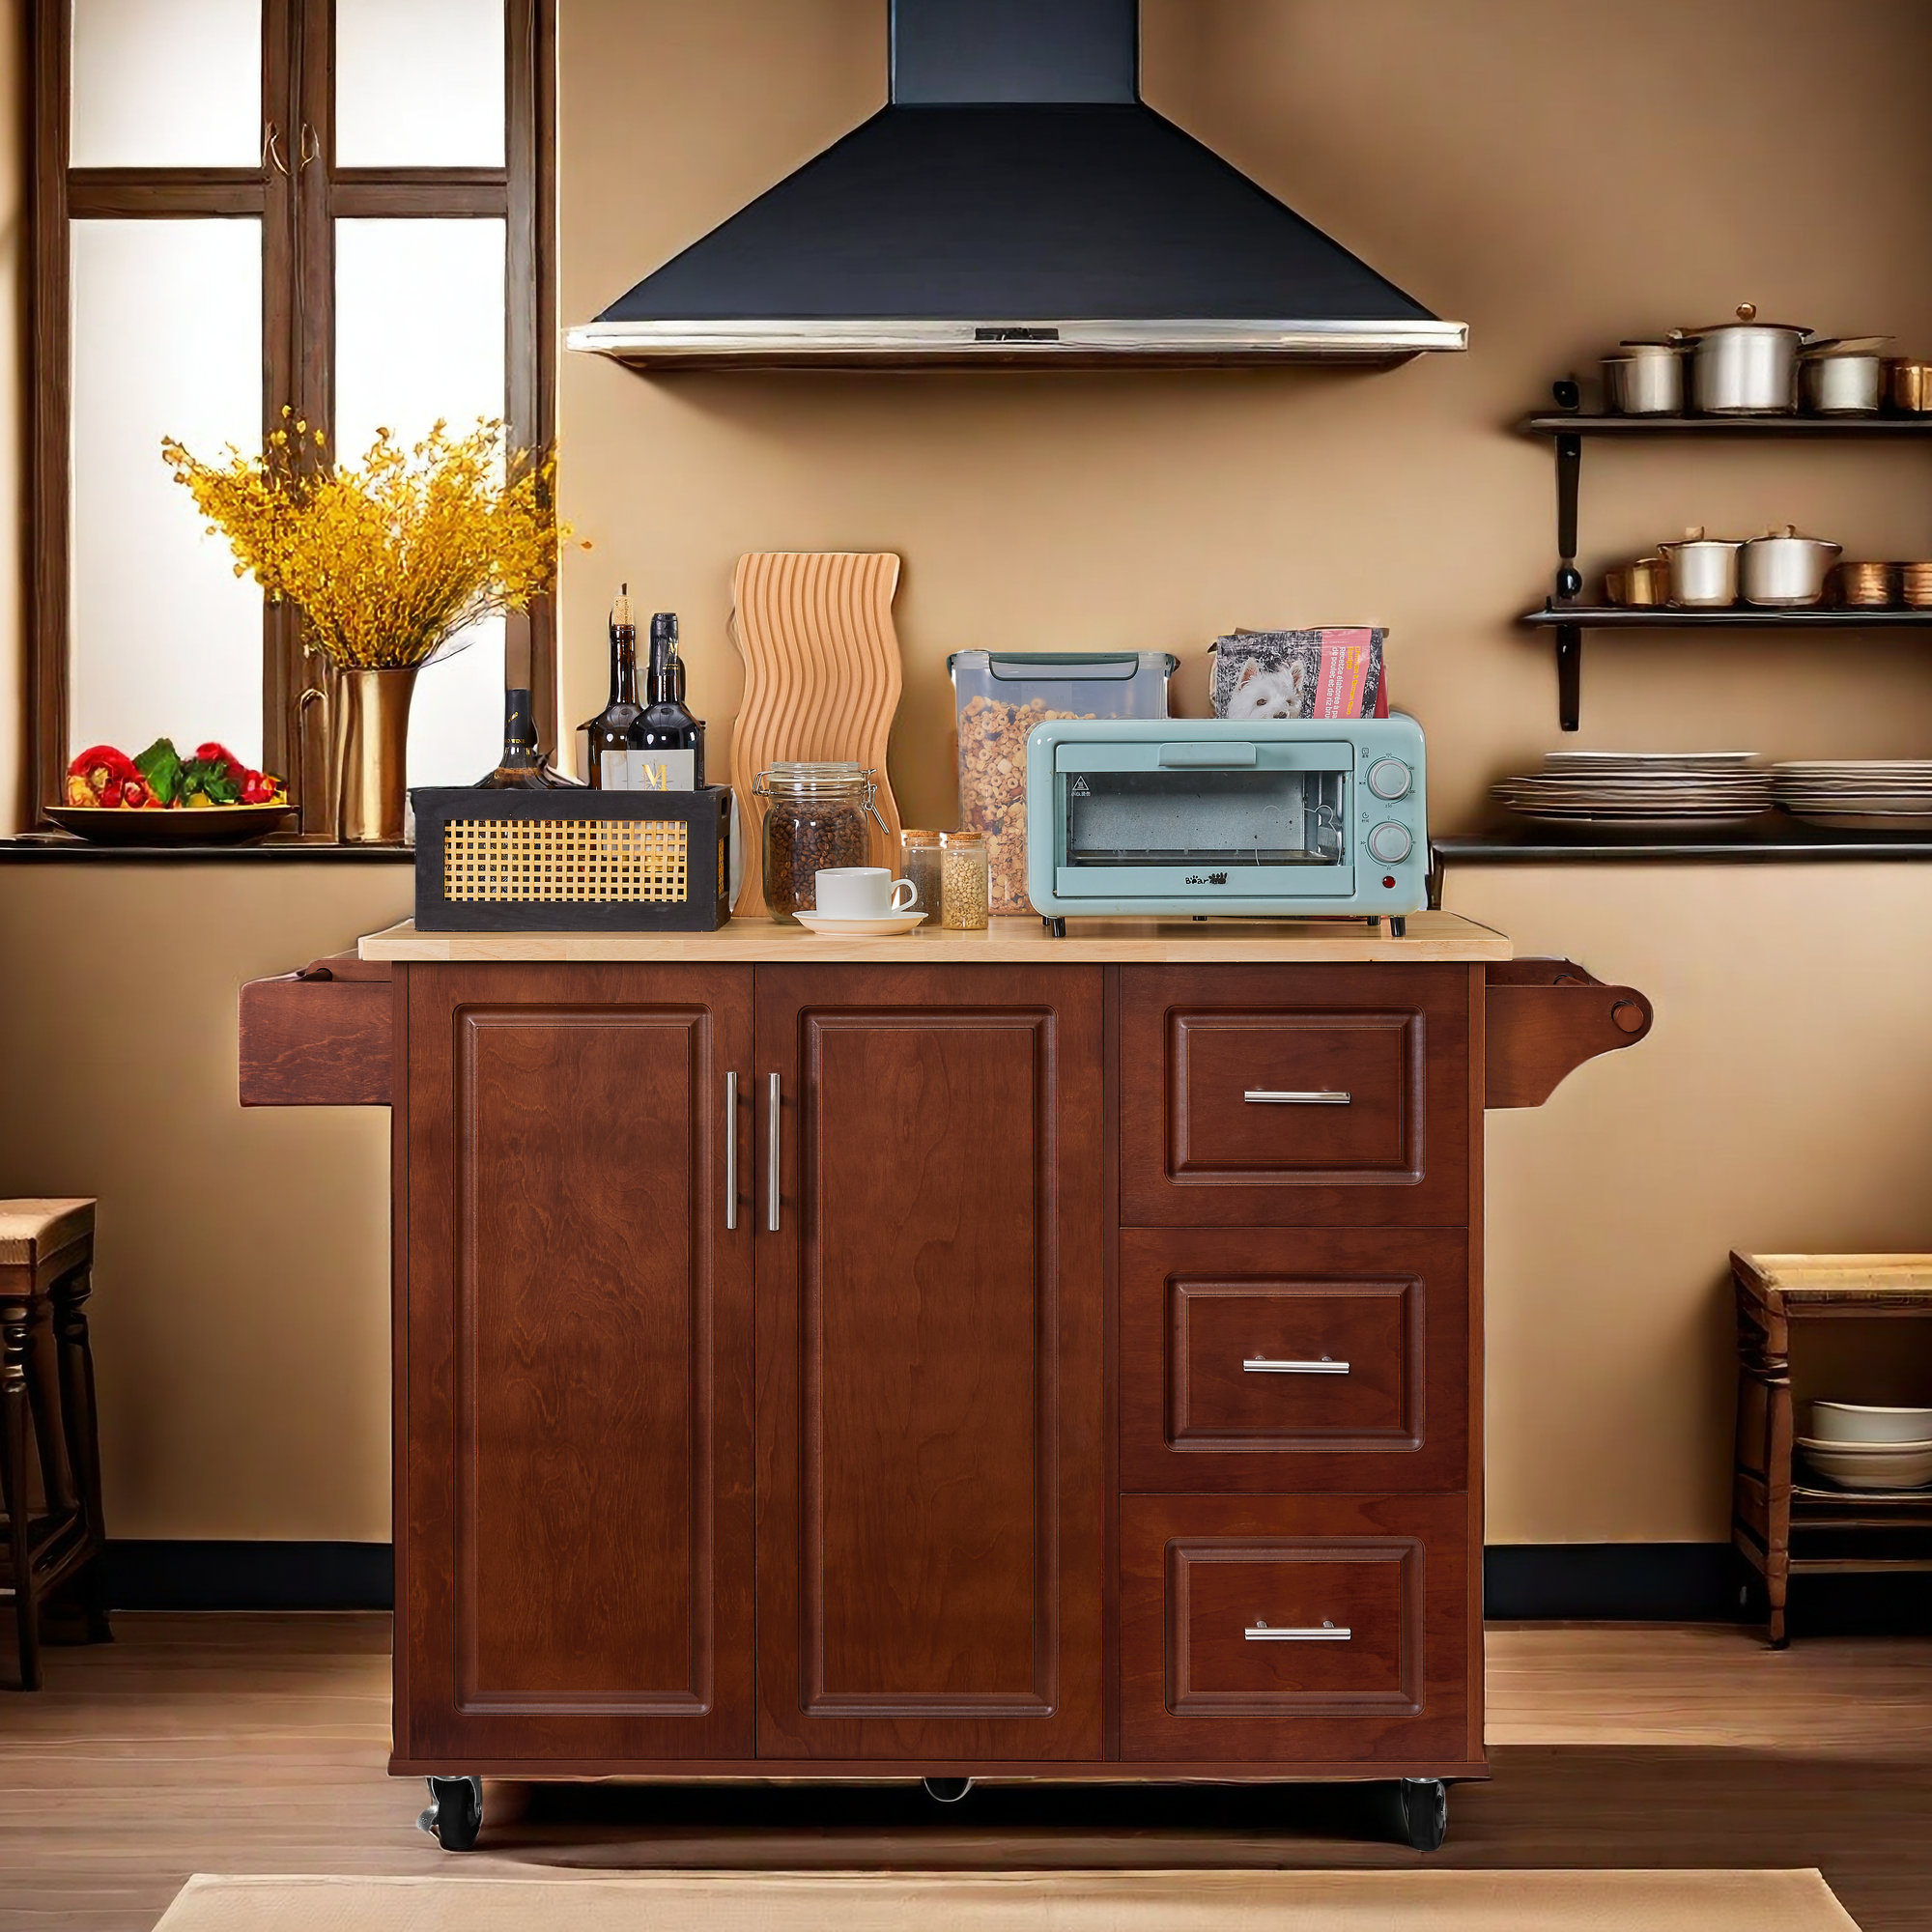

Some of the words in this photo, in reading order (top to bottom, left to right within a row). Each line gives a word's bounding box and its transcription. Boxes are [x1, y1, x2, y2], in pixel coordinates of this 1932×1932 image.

[1332, 647, 1339, 656] de
[1328, 678, 1335, 688] et
[1327, 688, 1333, 696] de
[1334, 675, 1344, 705] élaborée
[641, 764, 668, 791] M
